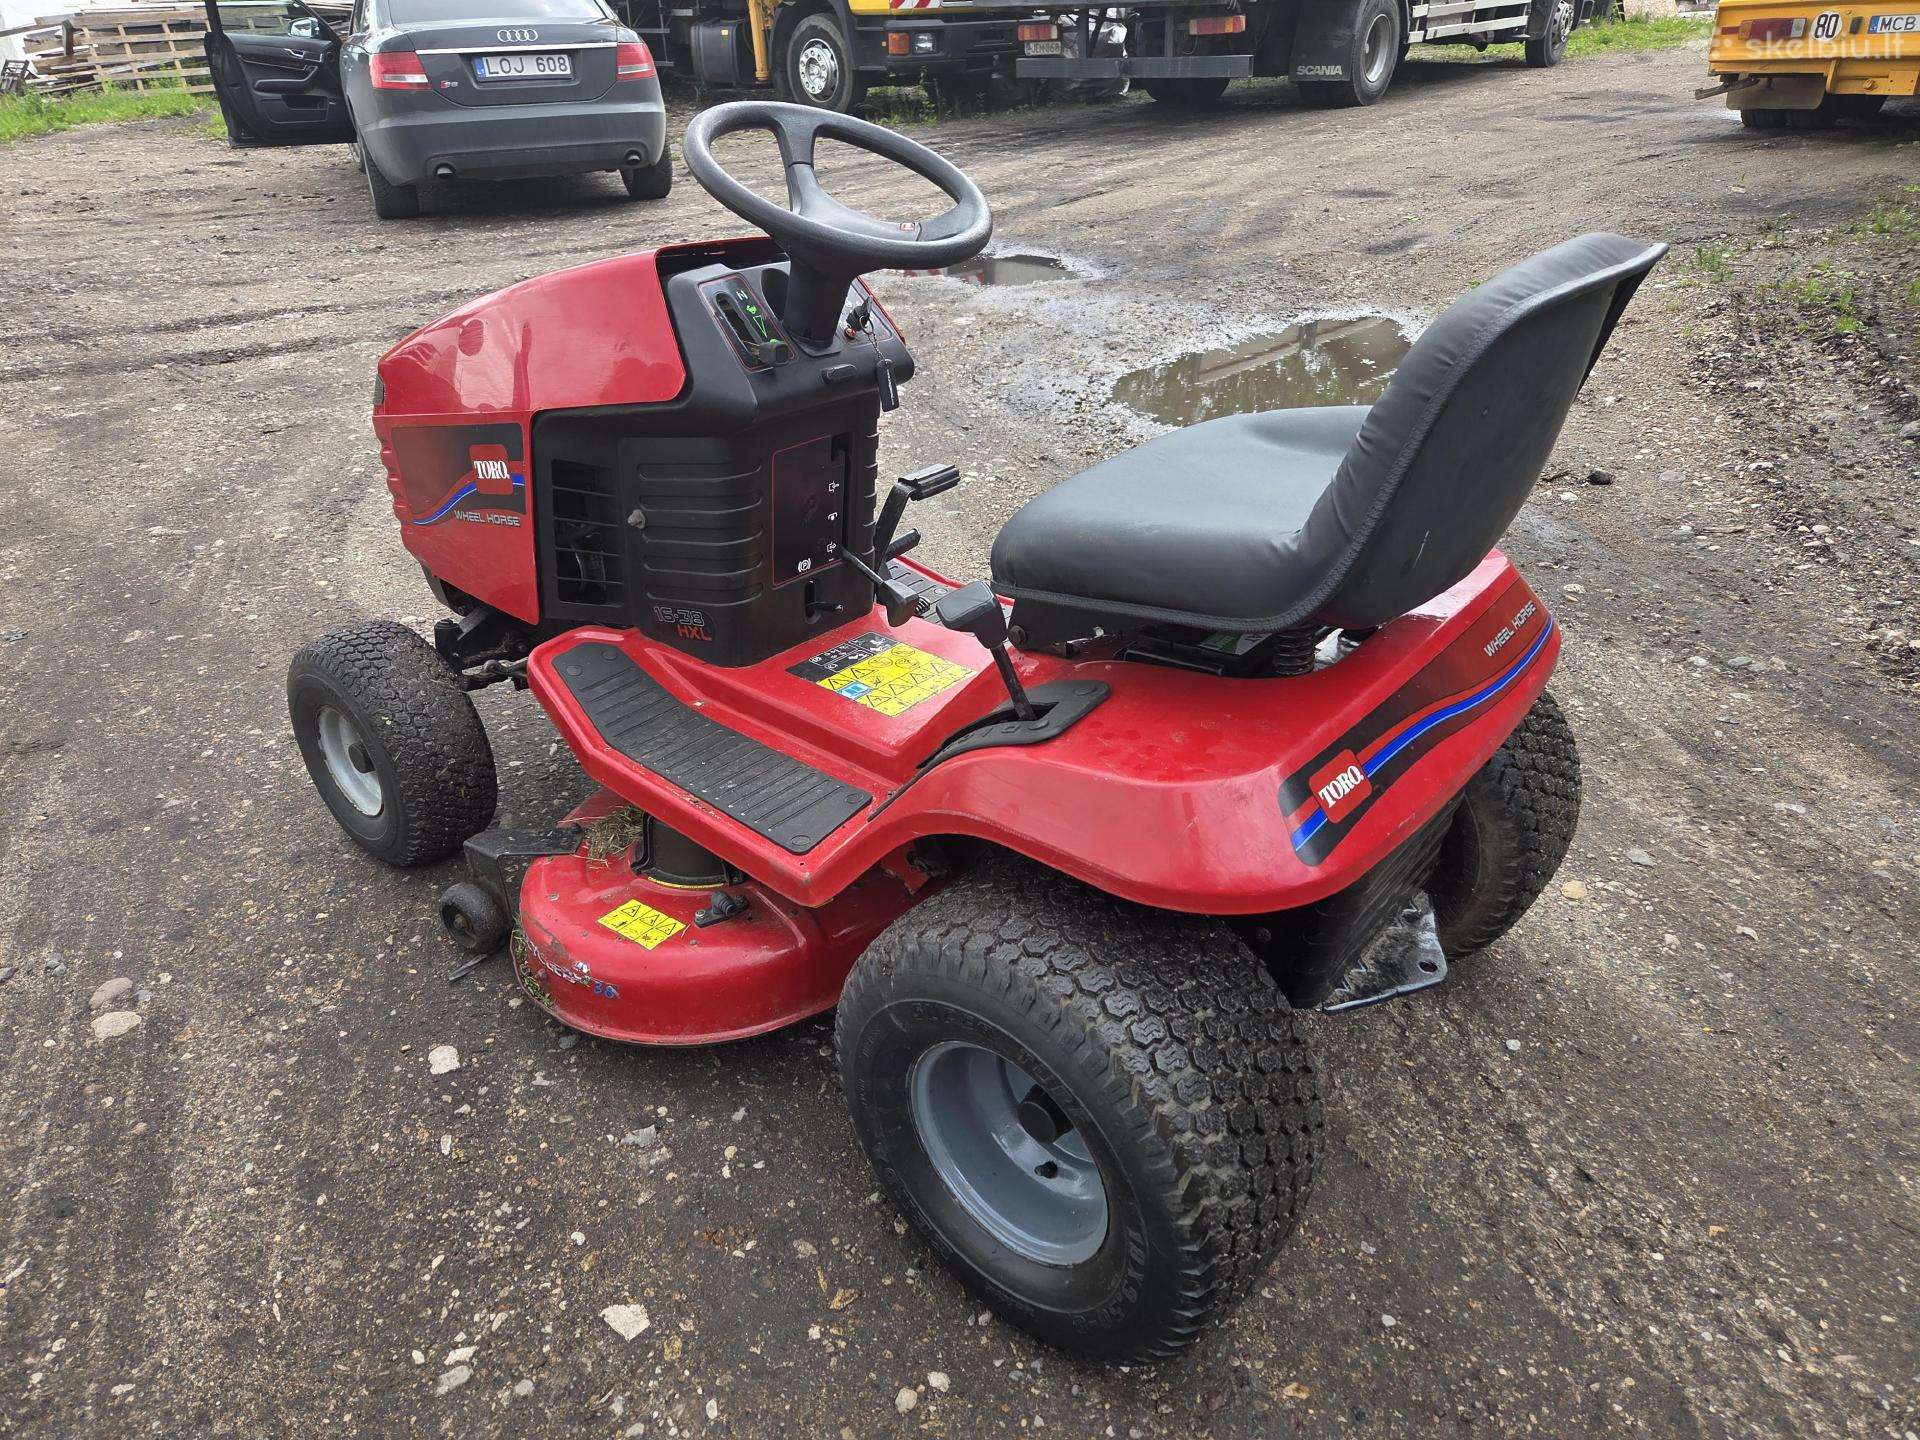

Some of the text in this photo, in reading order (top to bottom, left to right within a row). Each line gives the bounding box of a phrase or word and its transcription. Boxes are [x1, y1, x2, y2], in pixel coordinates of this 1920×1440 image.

[1815, 13, 1840, 39] 80
[485, 56, 568, 75] LOJ 608
[1296, 65, 1343, 76] SCANIA
[473, 460, 510, 479] TORO
[453, 509, 521, 528] WHEEL HORSE
[1483, 602, 1536, 657] WHEEL HORSE
[1318, 765, 1364, 808] TORO
